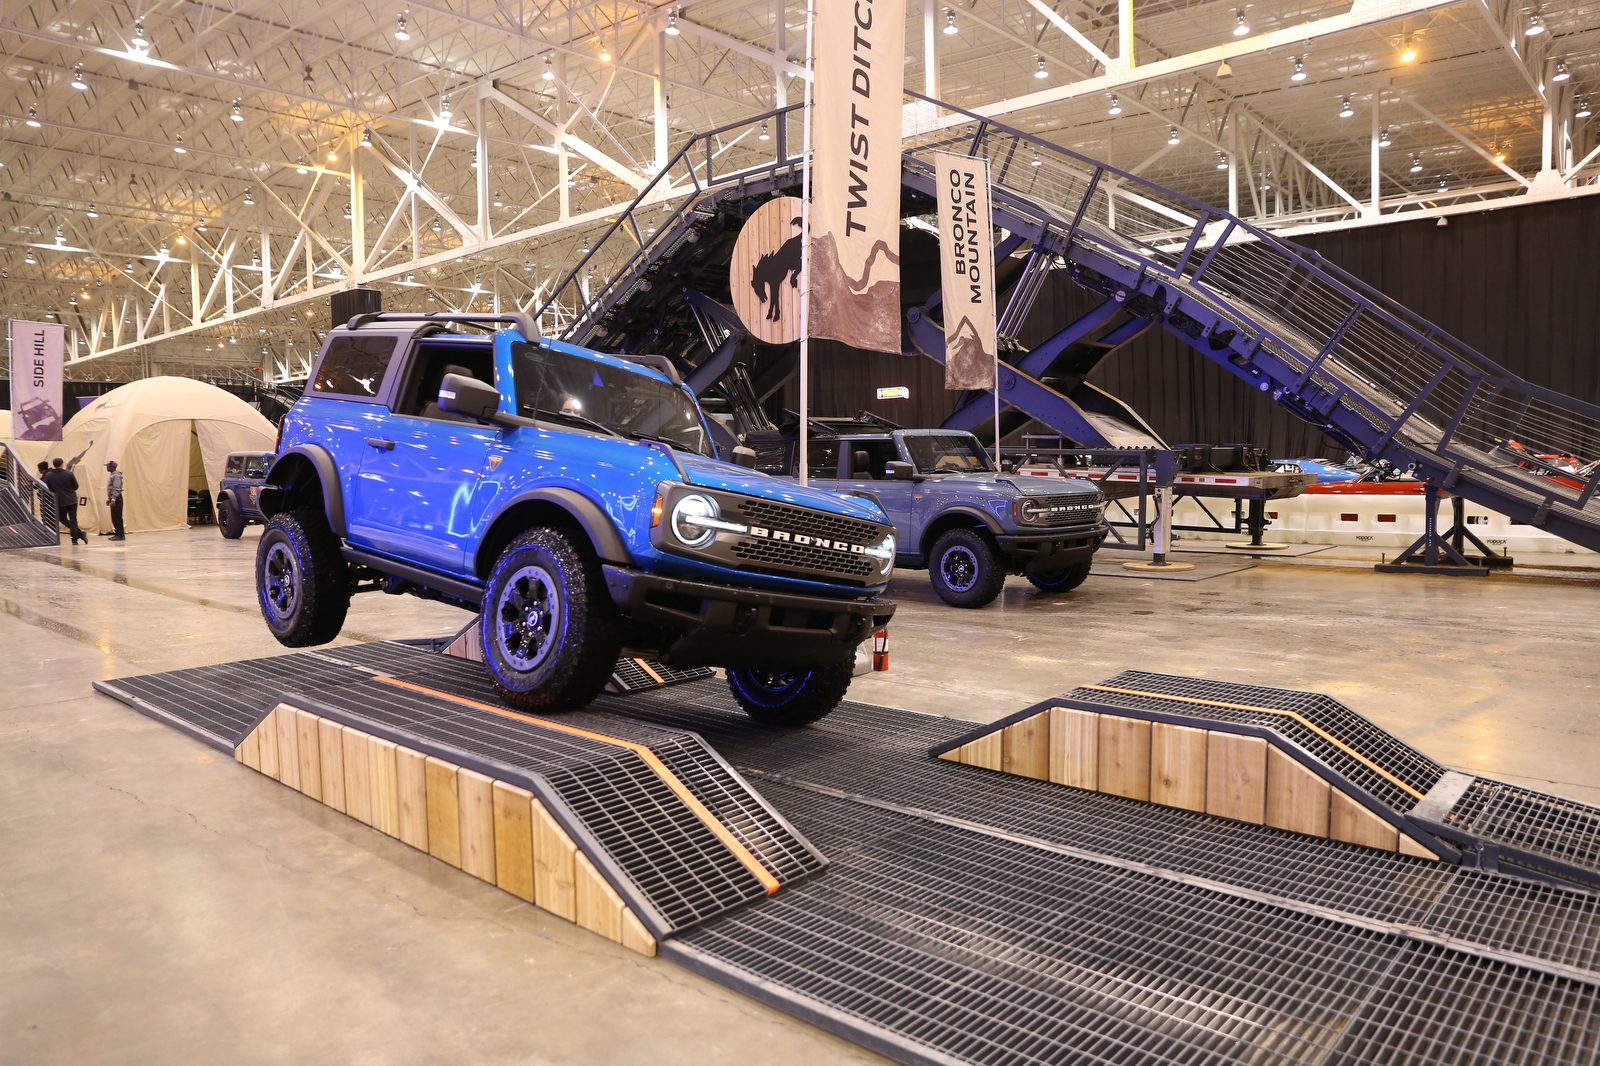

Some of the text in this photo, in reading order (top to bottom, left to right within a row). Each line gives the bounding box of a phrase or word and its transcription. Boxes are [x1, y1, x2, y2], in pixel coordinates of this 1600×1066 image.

[846, 0, 873, 237] TWIST DITC
[949, 169, 967, 275] BRONCO
[964, 172, 982, 304] MOUNTAIN
[33, 330, 45, 388] SIDE HILL
[750, 526, 865, 554] BRONCO
[1050, 504, 1094, 512] BRONCO
